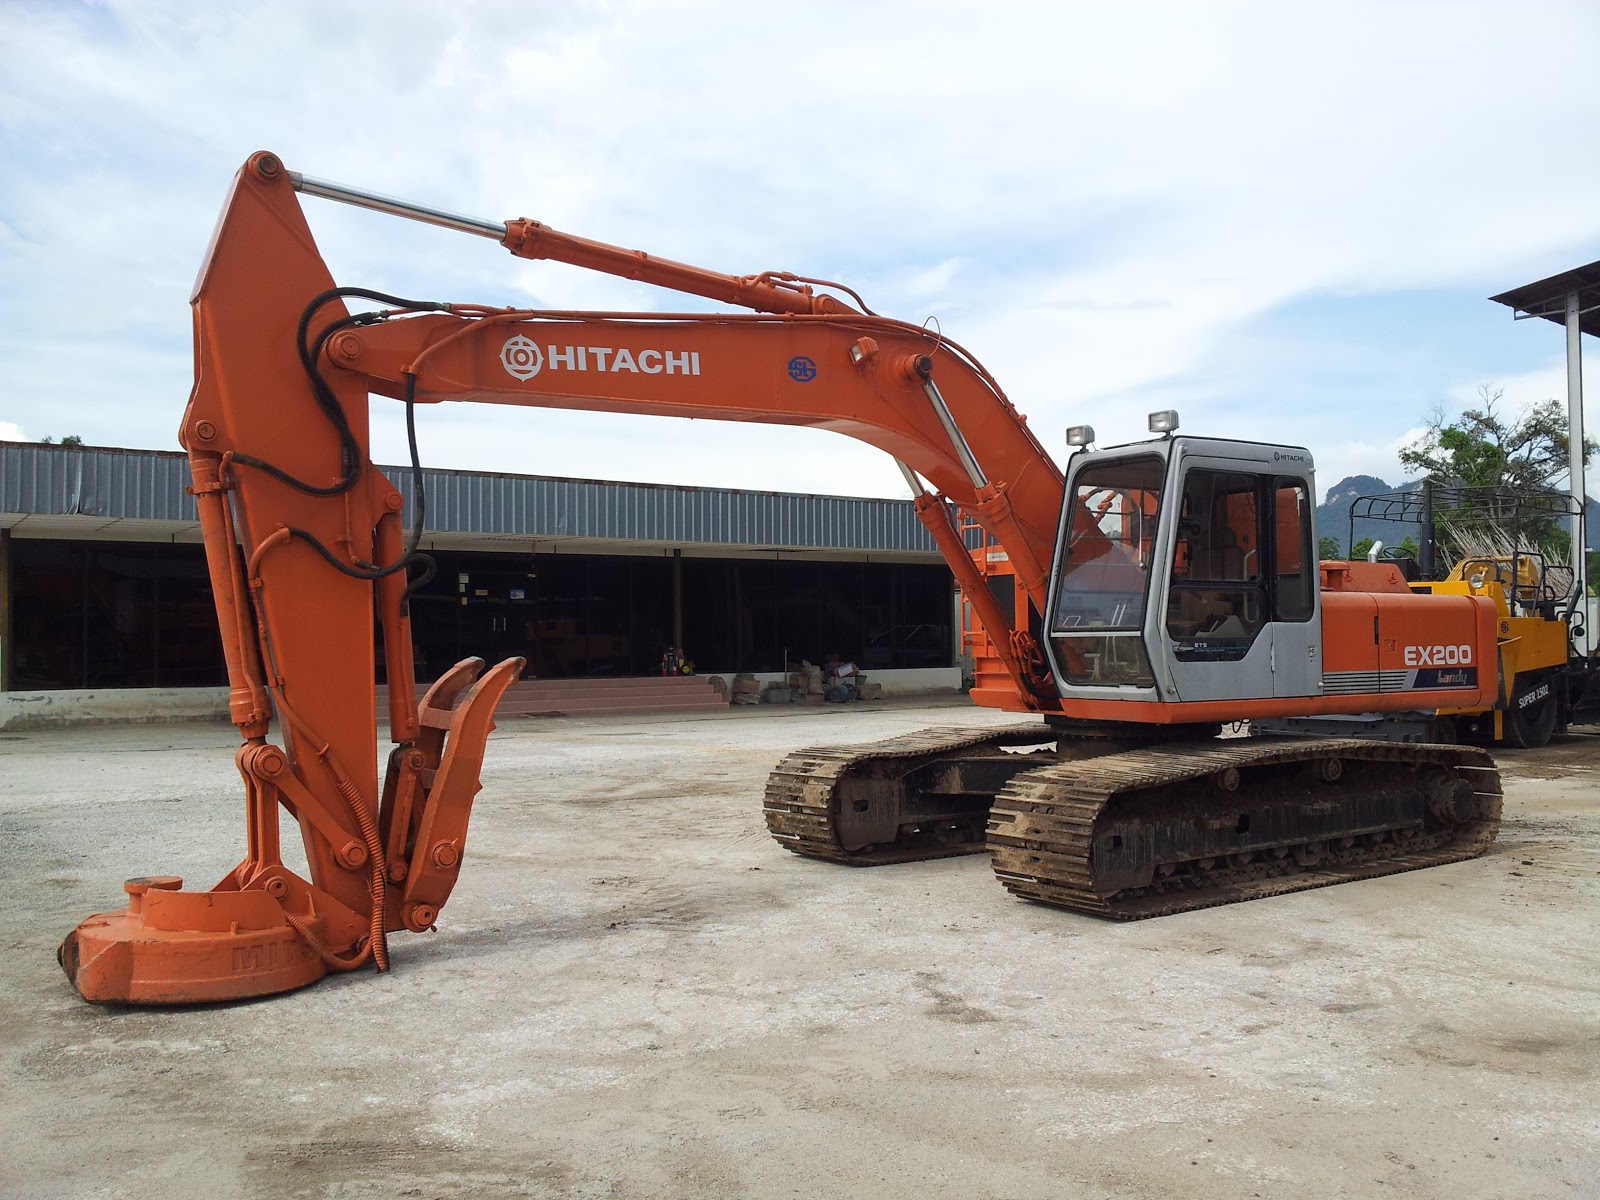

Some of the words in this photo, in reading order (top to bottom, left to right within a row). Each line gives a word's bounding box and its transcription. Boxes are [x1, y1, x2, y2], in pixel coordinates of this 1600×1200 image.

[548, 344, 700, 376] HITACHI
[1280, 454, 1305, 462] HITACHI
[1404, 644, 1472, 666] EX200
[1518, 691, 1536, 709] SUPER
